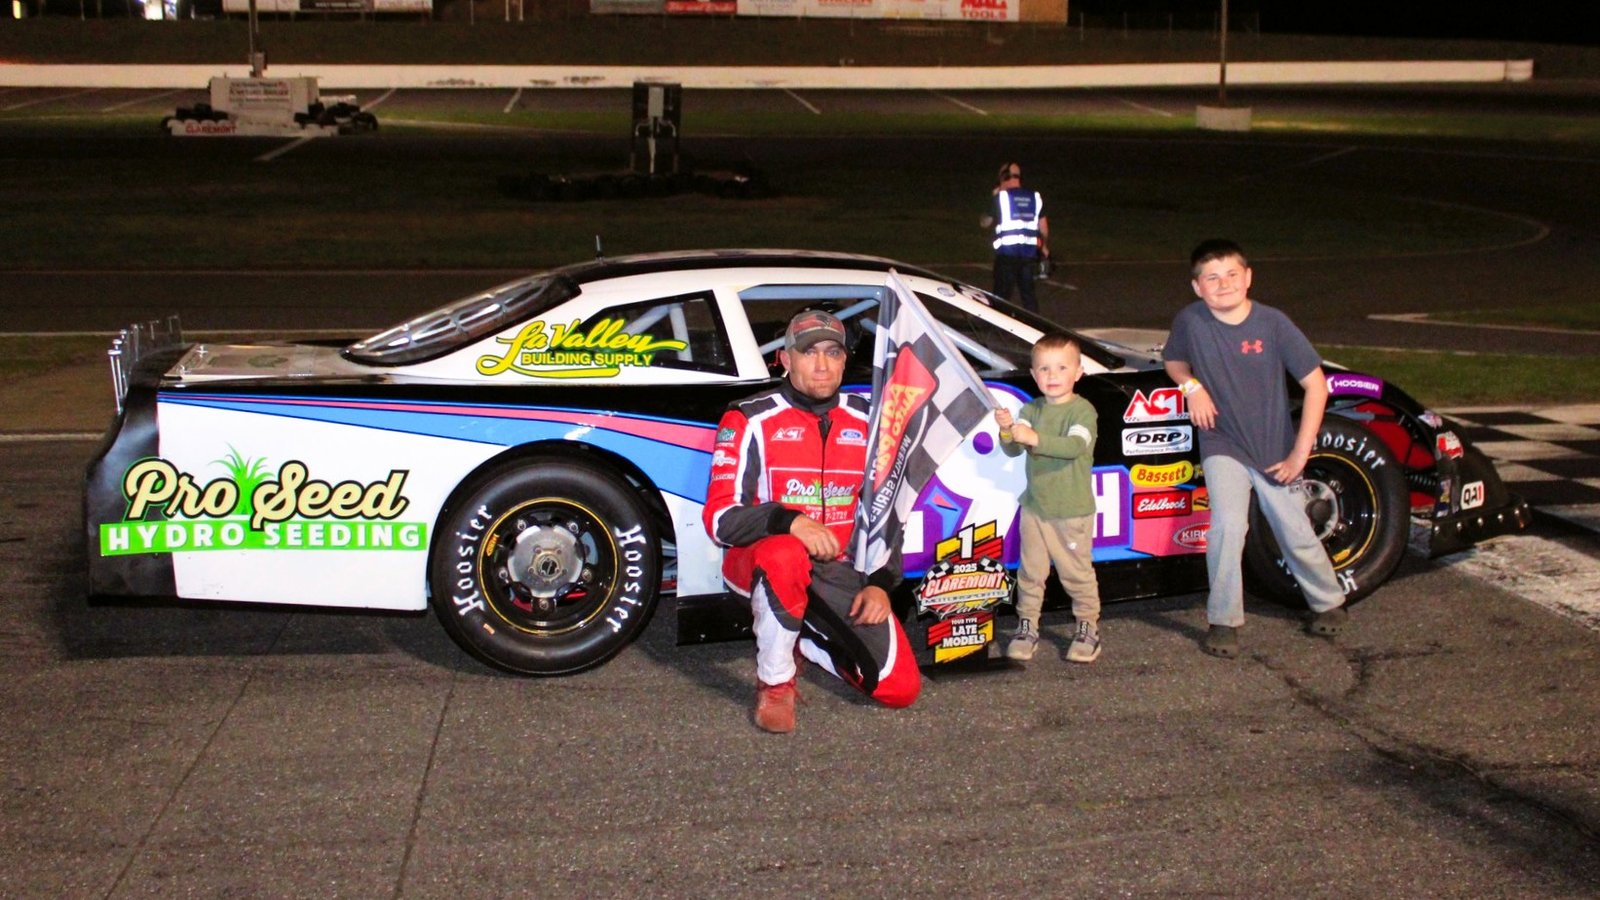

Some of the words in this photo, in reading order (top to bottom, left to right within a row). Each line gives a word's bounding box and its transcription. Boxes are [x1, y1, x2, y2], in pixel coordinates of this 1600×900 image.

[521, 352, 592, 366] BUILDING
[595, 353, 653, 367] SUPPLY
[1334, 380, 1379, 391] HOOSIER
[1136, 432, 1182, 444] DRP
[1312, 432, 1386, 470] oosier
[1136, 465, 1187, 483] Bassett
[123, 457, 240, 520] Pro
[250, 460, 410, 532] Seed
[786, 479, 816, 496] Pro
[1463, 484, 1483, 506] QA1
[1138, 498, 1186, 512] Edelbrock
[108, 523, 245, 551] HYDRO
[264, 523, 420, 548] SEEDING
[957, 524, 975, 559] 1
[1182, 529, 1207, 540] KIRK
[452, 504, 493, 616] Hoosier
[953, 563, 977, 574] 2025
[606, 524, 647, 633] Hoosier
[924, 572, 1005, 599] CLAREMONT
[952, 624, 978, 637] LATE
[942, 634, 986, 648] MODELS
